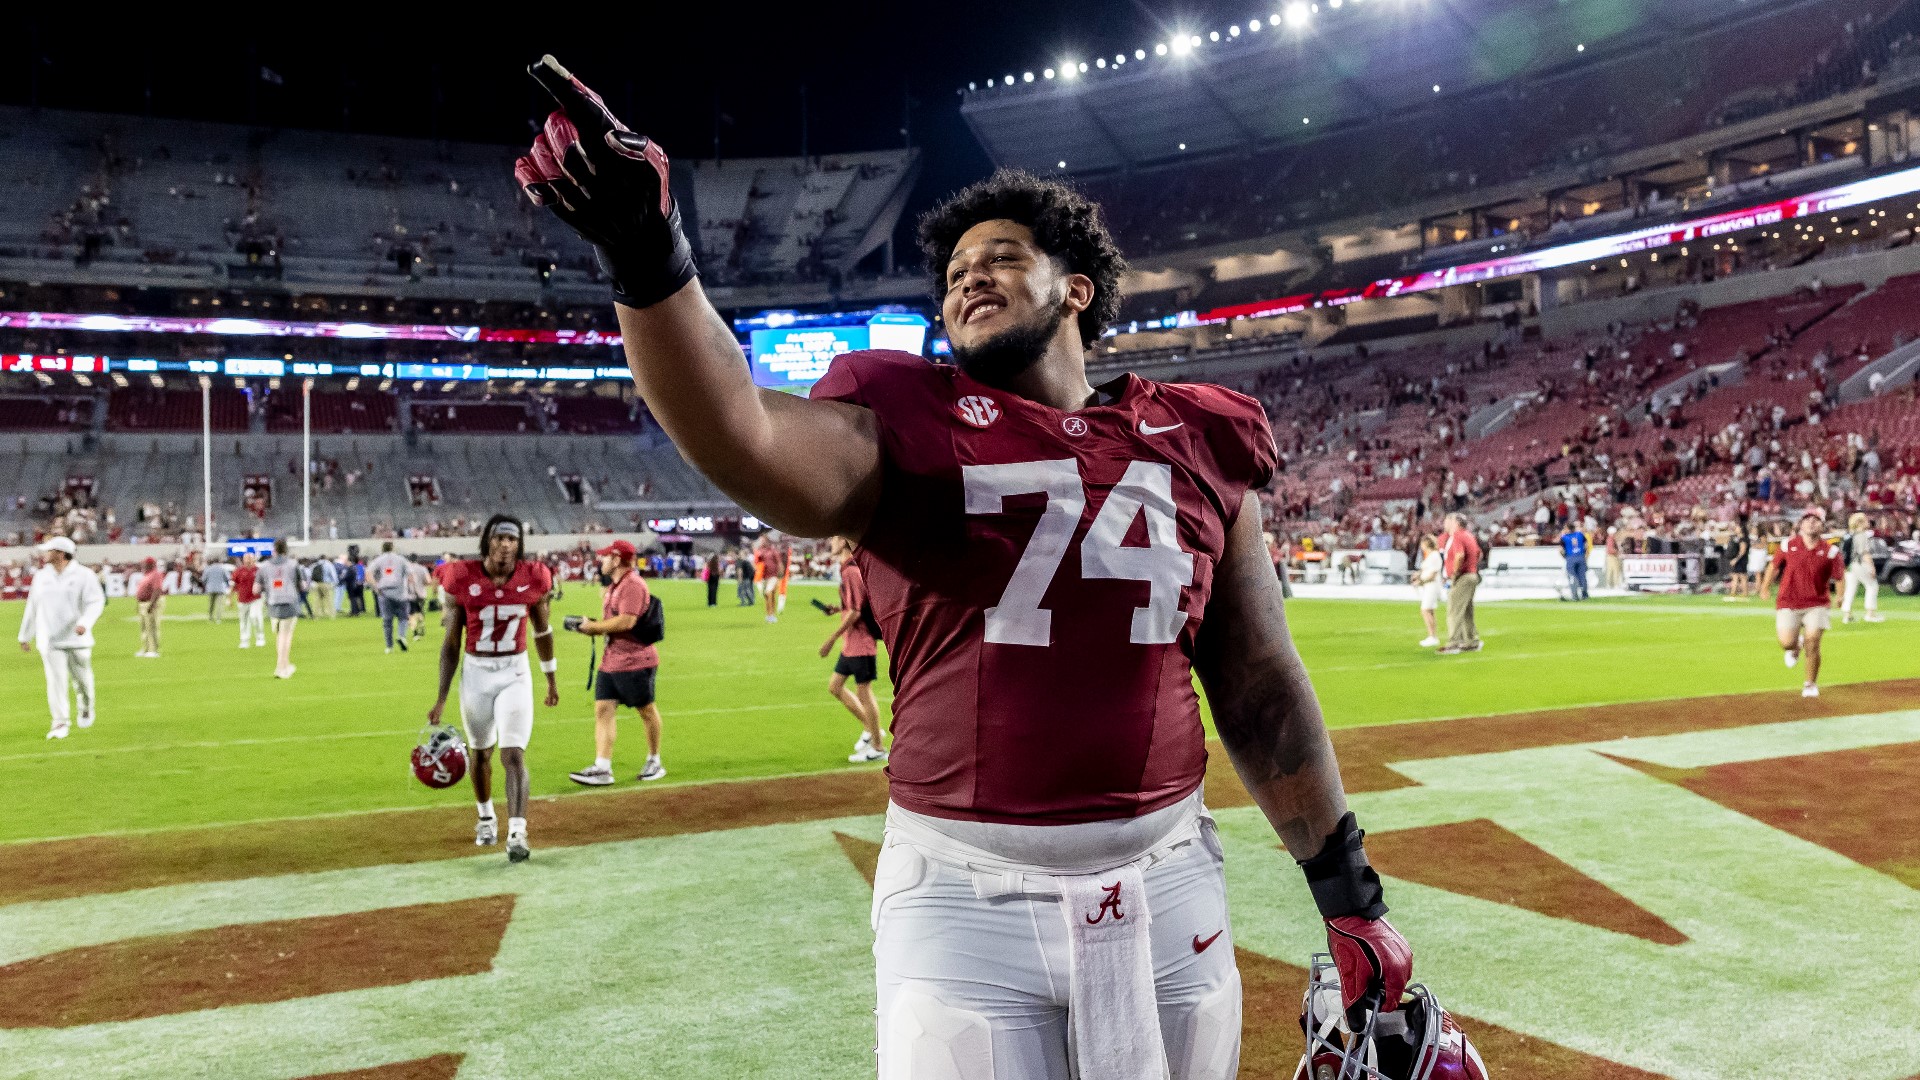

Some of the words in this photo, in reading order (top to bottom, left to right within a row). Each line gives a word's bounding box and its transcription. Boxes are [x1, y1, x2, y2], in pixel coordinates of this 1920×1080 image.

[957, 395, 999, 427] SEC
[962, 457, 1194, 647] 74
[475, 604, 528, 652] 17
[1086, 881, 1124, 924] A
